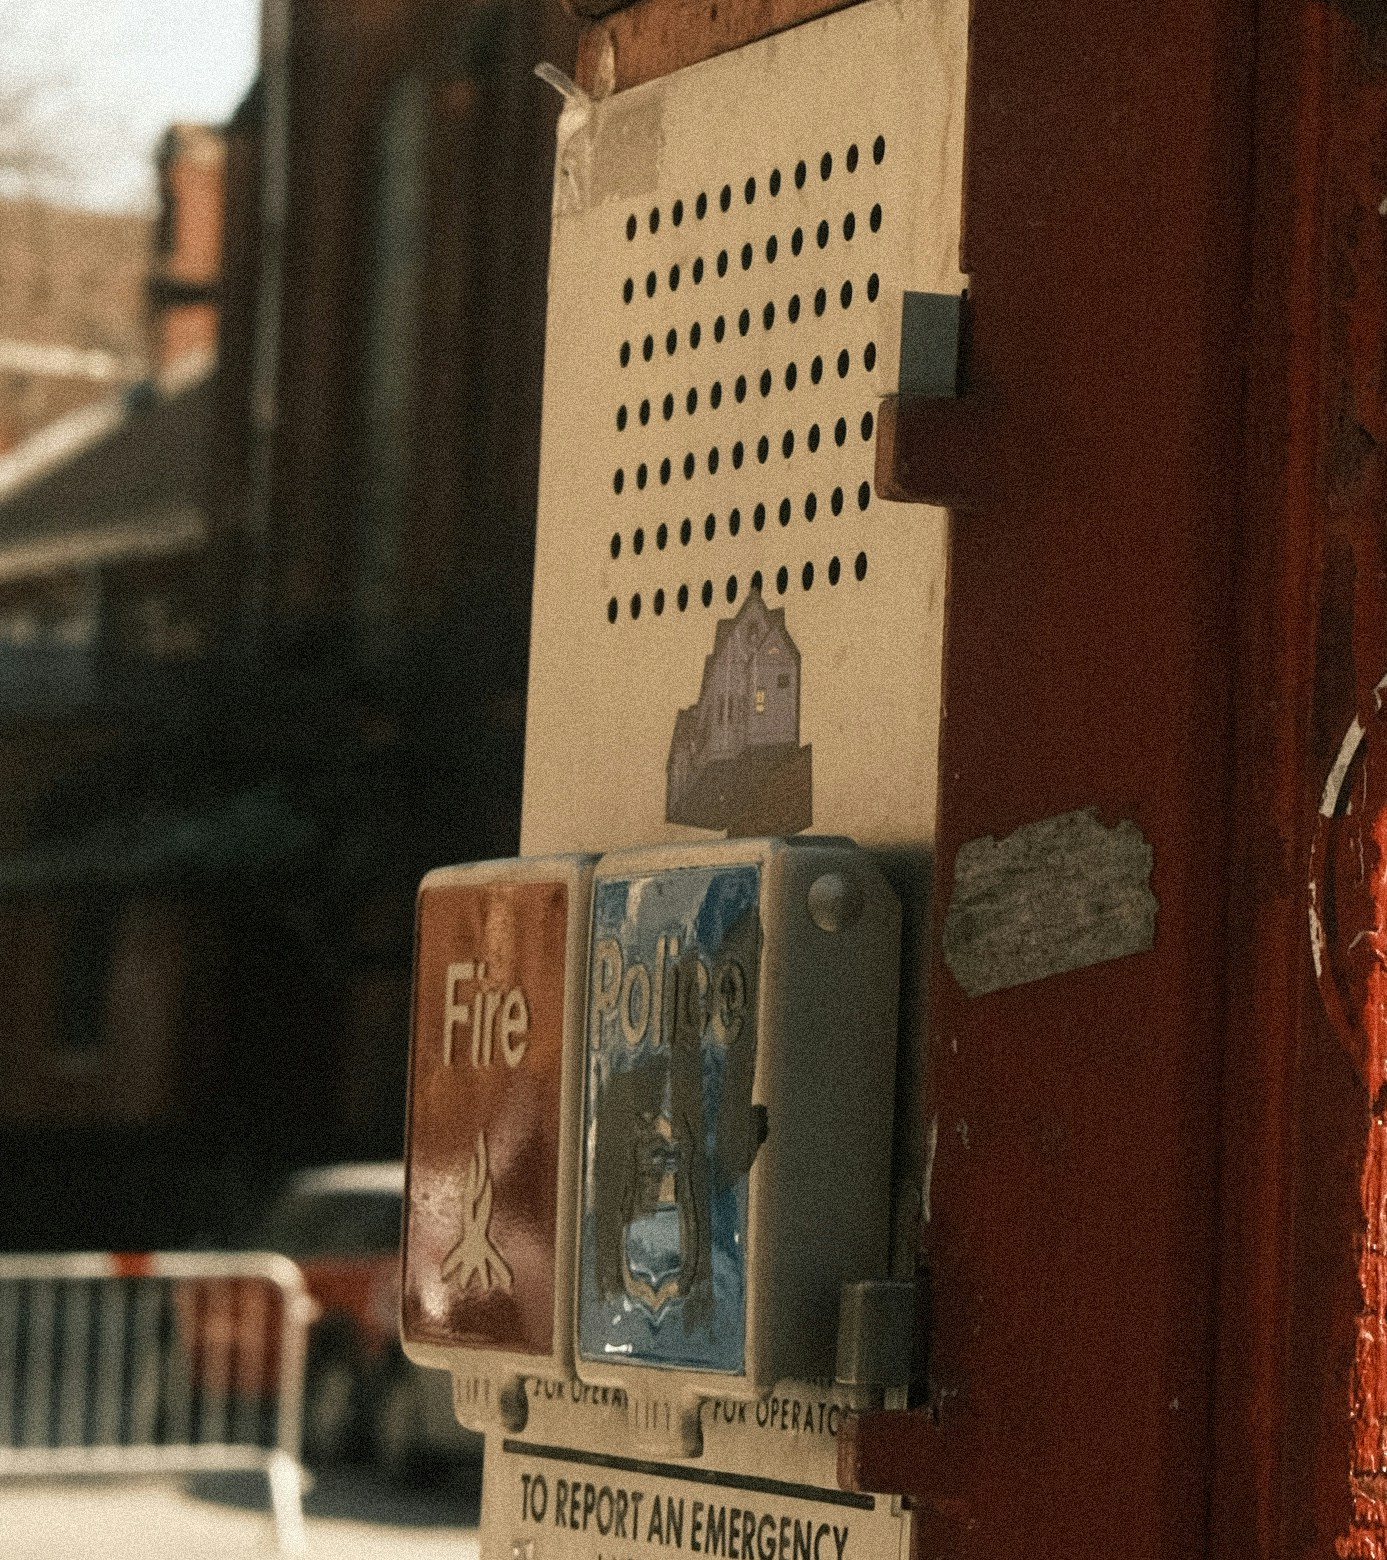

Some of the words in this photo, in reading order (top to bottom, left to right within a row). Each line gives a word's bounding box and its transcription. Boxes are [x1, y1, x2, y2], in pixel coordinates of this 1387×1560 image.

[444, 962, 529, 1069] Fire
[592, 936, 746, 1049] Police
[521, 1473, 548, 1523] TO
[555, 1478, 644, 1540] REPORT
[647, 1494, 685, 1549] AN
